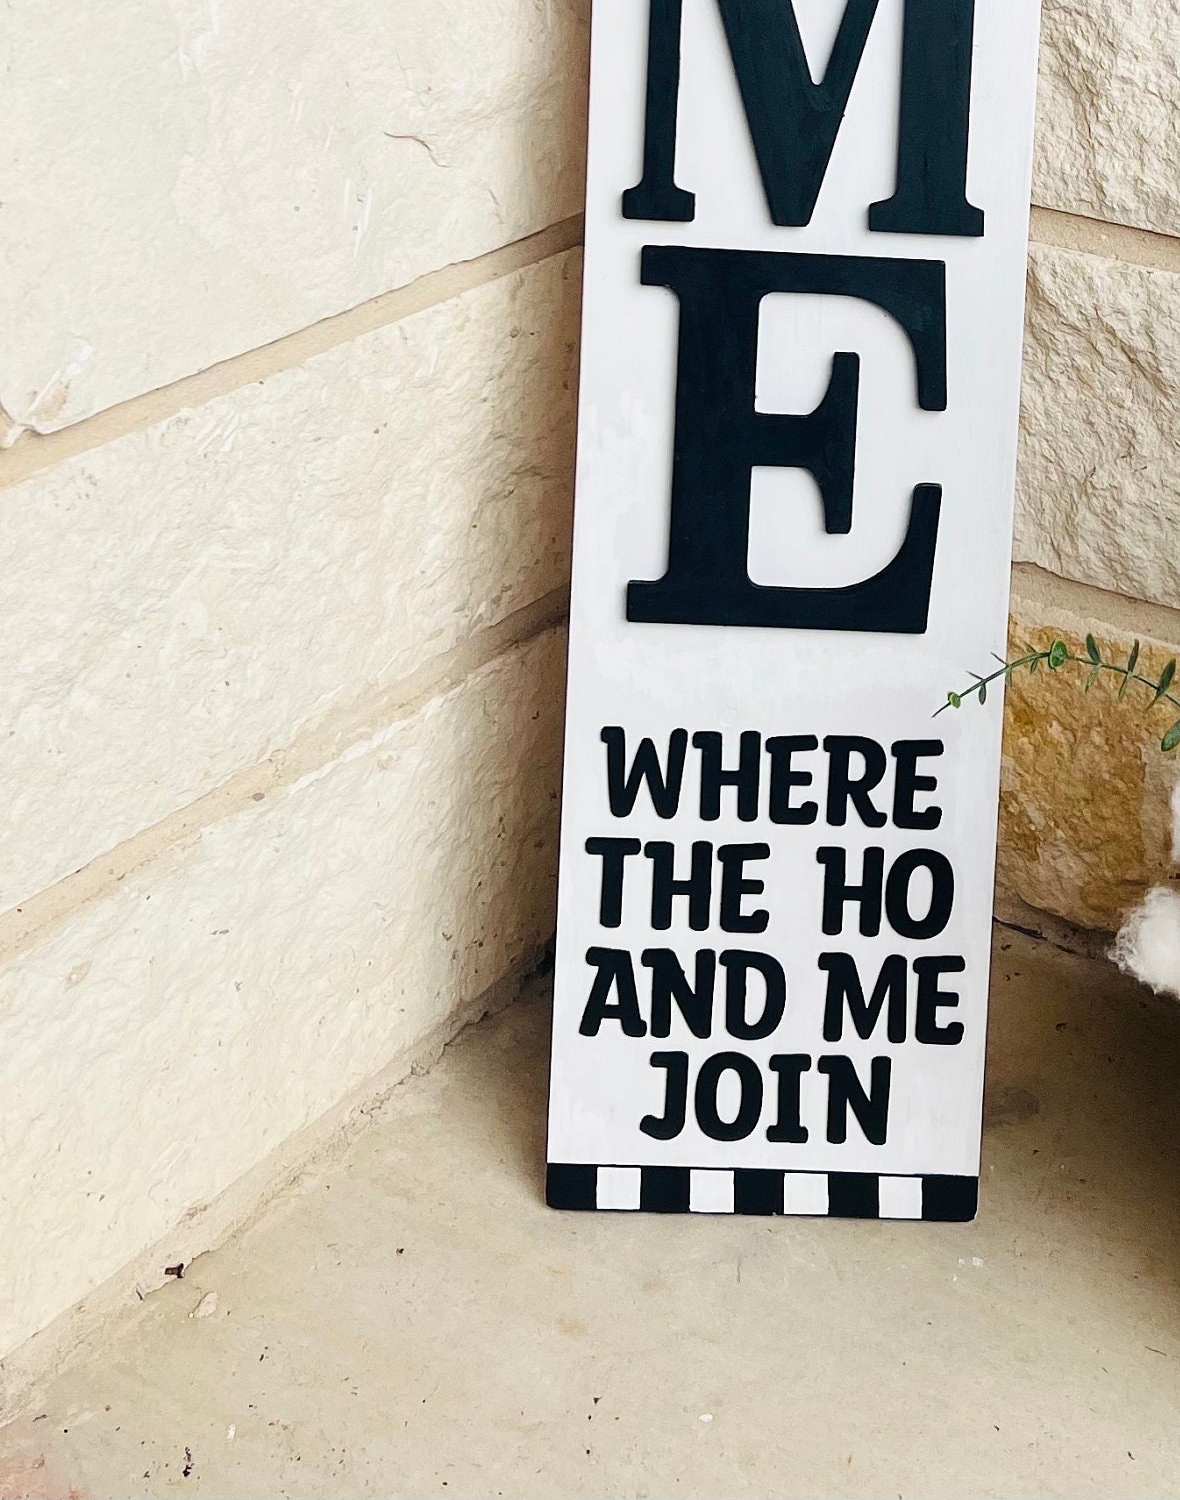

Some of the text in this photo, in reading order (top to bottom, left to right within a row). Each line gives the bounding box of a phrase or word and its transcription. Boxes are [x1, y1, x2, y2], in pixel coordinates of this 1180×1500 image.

[600, 725, 945, 830] WHERE
[584, 836, 955, 940] THE HO
[578, 946, 966, 1046] AND ME
[639, 1050, 892, 1146] JOIN
